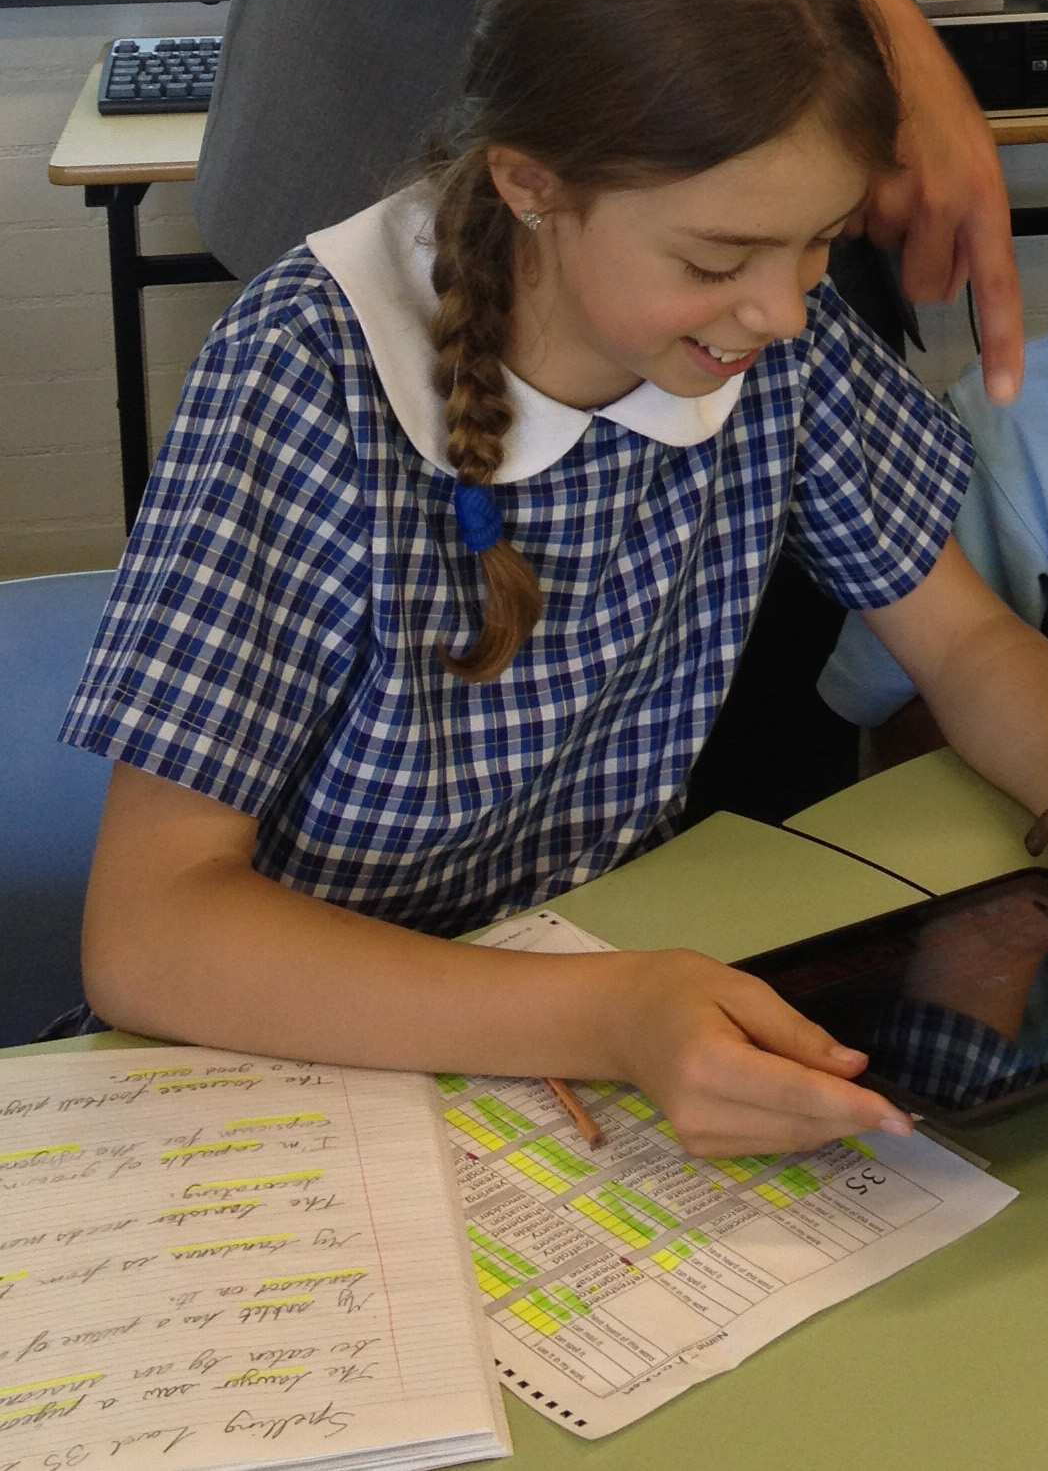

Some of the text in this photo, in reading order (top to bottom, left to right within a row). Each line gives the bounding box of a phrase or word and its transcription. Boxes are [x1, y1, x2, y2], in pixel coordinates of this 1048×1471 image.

[285, 1069, 333, 1086] The
[58, 1083, 149, 1111] football
[465, 1177, 507, 1203] yearling
[470, 1171, 498, 1190] yeast
[846, 1162, 886, 1195] 35
[290, 1194, 344, 1212] The
[477, 1190, 526, 1220] smoulder
[489, 1198, 535, 1225] situation
[56, 1219, 138, 1246] needs
[489, 1204, 545, 1238] sharpened
[513, 1213, 554, 1237] sensible
[532, 1217, 564, 1239] scurry
[312, 1228, 361, 1250] My
[533, 1225, 574, 1250] scissors
[542, 1230, 584, 1256] scenery
[552, 1237, 594, 1264] scaffold
[172, 1239, 301, 1268] bandanna
[567, 1250, 614, 1278] rehearse
[38, 1258, 111, 1286] from
[573, 1264, 634, 1301] refrigerator
[216, 1286, 247, 1297] on
[254, 1273, 368, 1298] bandicoot
[580, 1271, 644, 1309] refreshment
[239, 1300, 315, 1324] anklet
[336, 1287, 373, 1313] My
[61, 1316, 142, 1346] picture
[184, 1310, 224, 1328] has
[15, 1330, 49, 1362] of
[249, 1347, 320, 1370] eaten
[330, 1338, 382, 1357] be
[133, 1363, 174, 1379] an
[324, 1362, 379, 1383] The
[97, 1398, 118, 1409] a
[143, 1384, 200, 1400] saw
[224, 1401, 354, 1439] Spelling
